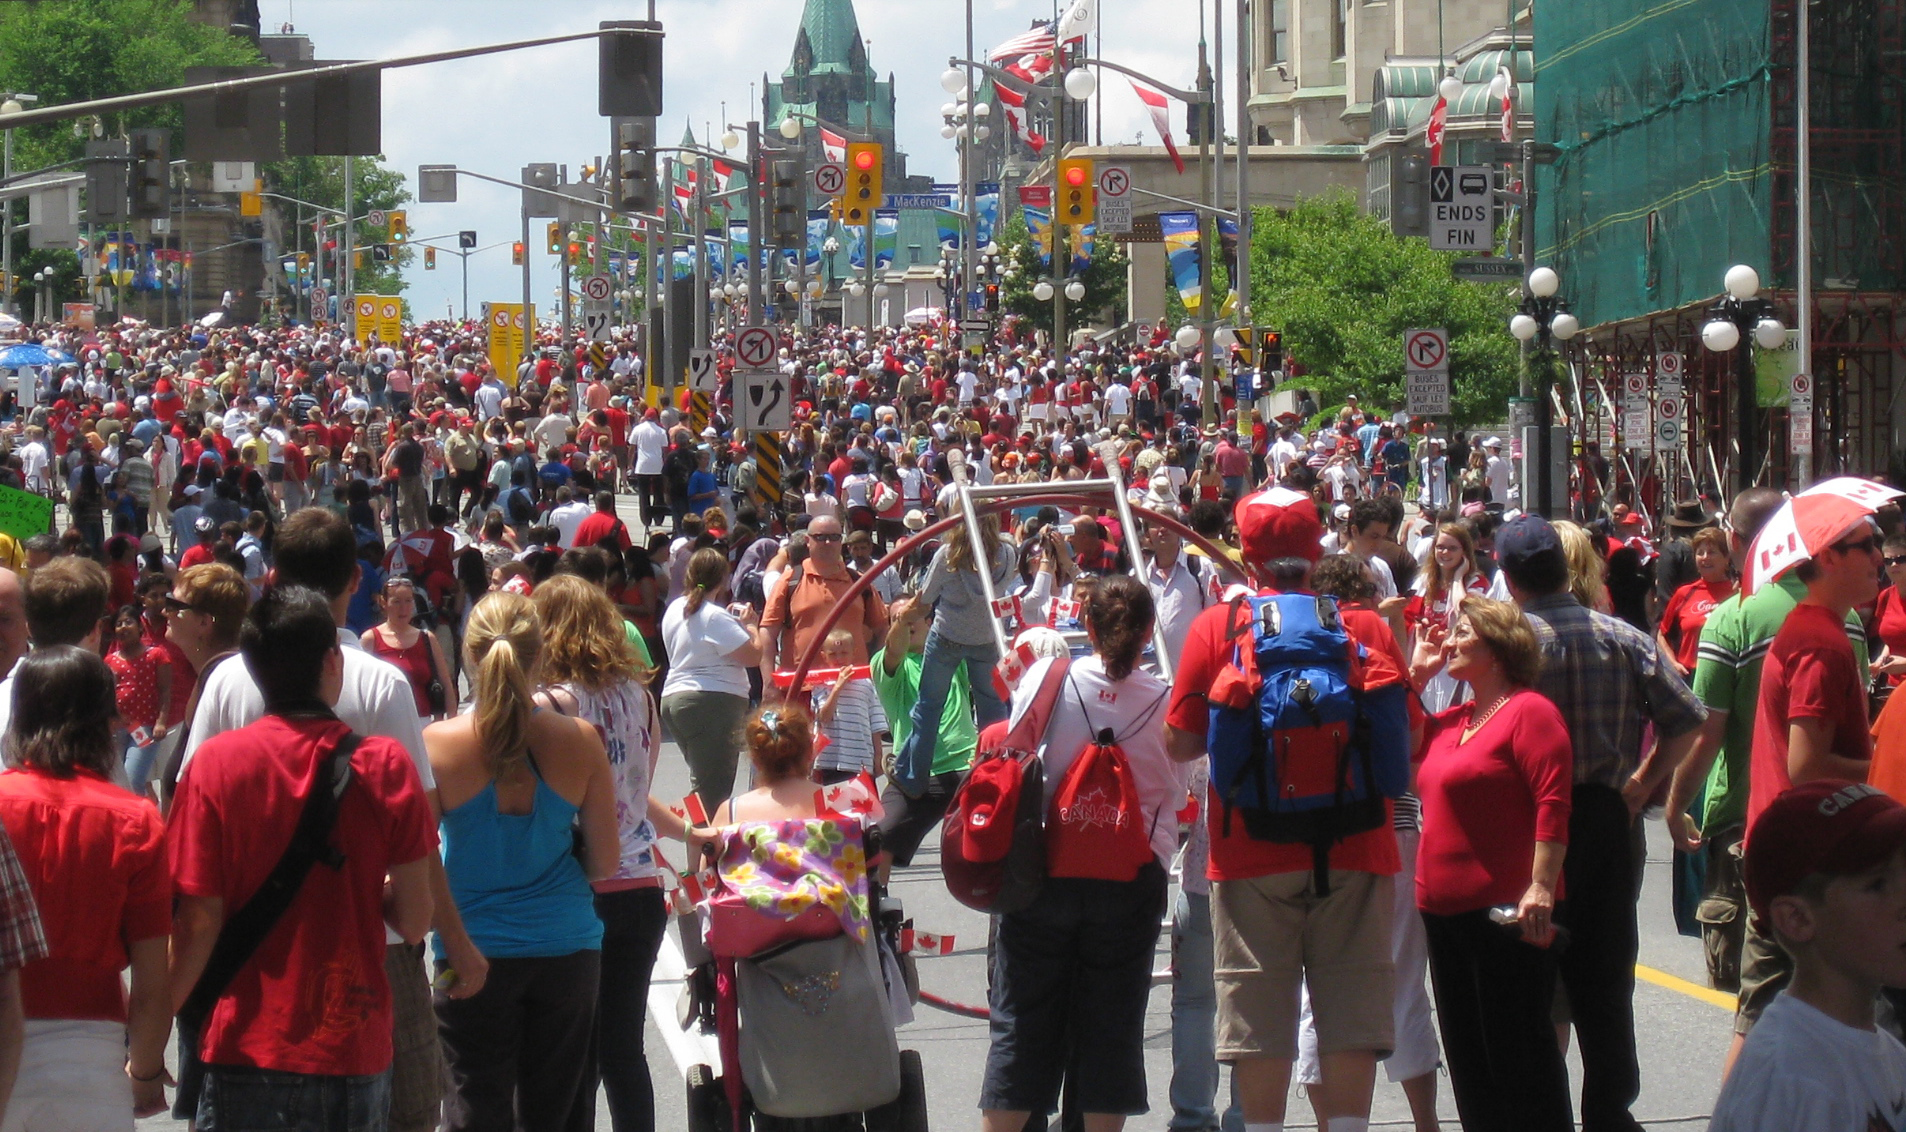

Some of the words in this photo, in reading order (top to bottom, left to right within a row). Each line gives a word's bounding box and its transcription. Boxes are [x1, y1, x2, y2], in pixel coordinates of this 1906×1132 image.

[893, 195, 947, 208] MacKenzie
[1437, 205, 1486, 221] ENDS
[1447, 229, 1475, 245] FIN
[1474, 263, 1508, 274] SUSSEX
[1414, 375, 1440, 384] BUSES
[1409, 384, 1446, 393] EXCEPTED
[1411, 395, 1428, 404] SAUF
[1430, 395, 1444, 403] LES
[1413, 404, 1443, 413] AUTOBUS
[1059, 803, 1130, 829] CANADA
